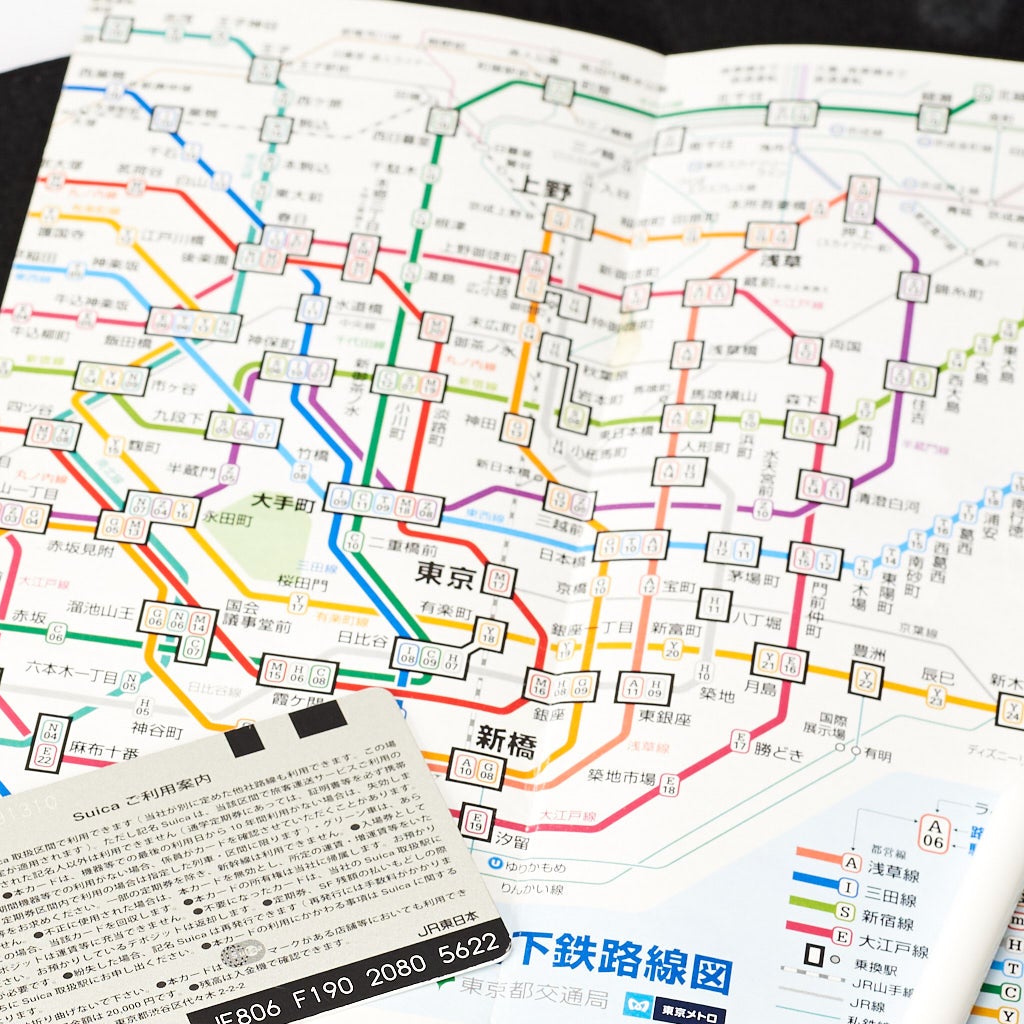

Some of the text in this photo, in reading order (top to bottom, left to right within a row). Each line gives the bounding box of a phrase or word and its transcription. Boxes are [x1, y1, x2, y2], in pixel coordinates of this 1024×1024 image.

[251, 492, 316, 514] 大手町
[202, 510, 254, 528] 永田町
[47, 540, 115, 559] 赤坂見附
[368, 536, 438, 558] 二重橋前
[277, 575, 328, 593] 桜田門
[415, 561, 477, 591] 東京
[66, 599, 135, 622] 溜池山王
[226, 599, 260, 614] 国会
[420, 601, 472, 621] 有楽町
[12, 609, 47, 625] 赤坂
[222, 612, 292, 634] 議事堂前
[733, 611, 783, 631] 八丁堀
[652, 621, 702, 638] 新富町
[337, 630, 388, 649] 日比谷
[853, 643, 887, 661] 豊洲
[25, 661, 118, 685] 六本木一丁目
[700, 687, 736, 704] 築地
[745, 680, 777, 698] 月島
[533, 707, 565, 722] 銀座
[639, 709, 692, 727] 東銀座
[131, 721, 184, 741] 神谷町
[69, 740, 140, 761] 麻布十番
[476, 725, 537, 760] 新橋
[755, 742, 804, 763] 勝どき
[865, 747, 892, 763] 有明
[588, 768, 656, 787] 築地市場
[72, 773, 212, 822] Suica ご利用案内
[928, 820, 942, 833] A
[496, 831, 530, 851] 汐留
[924, 835, 943, 849] 06
[505, 861, 566, 874] ゆりかもめ
[845, 857, 858, 869] A
[868, 860, 920, 883] 浅草線
[501, 882, 564, 896] りんかい線
[864, 885, 917, 908] 三田線
[840, 907, 850, 917] S
[862, 909, 914, 932] 新宿線
[417, 910, 479, 937] JR東日本
[836, 931, 848, 943] E
[859, 934, 929, 959] 大江戸線
[1010, 940, 1022, 951] H
[292, 976, 353, 1009] F190
[365, 954, 426, 986] 2080
[437, 932, 499, 963] 5622
[855, 959, 898, 978] 乗換駅
[1008, 963, 1019, 974] T
[460, 977, 609, 1010] 東京都交通局
[1004, 987, 1017, 999] C
[662, 1005, 718, 1024] 東京メトロ
[850, 998, 885, 1013] JR線
[1003, 1011, 1014, 1022] Y
